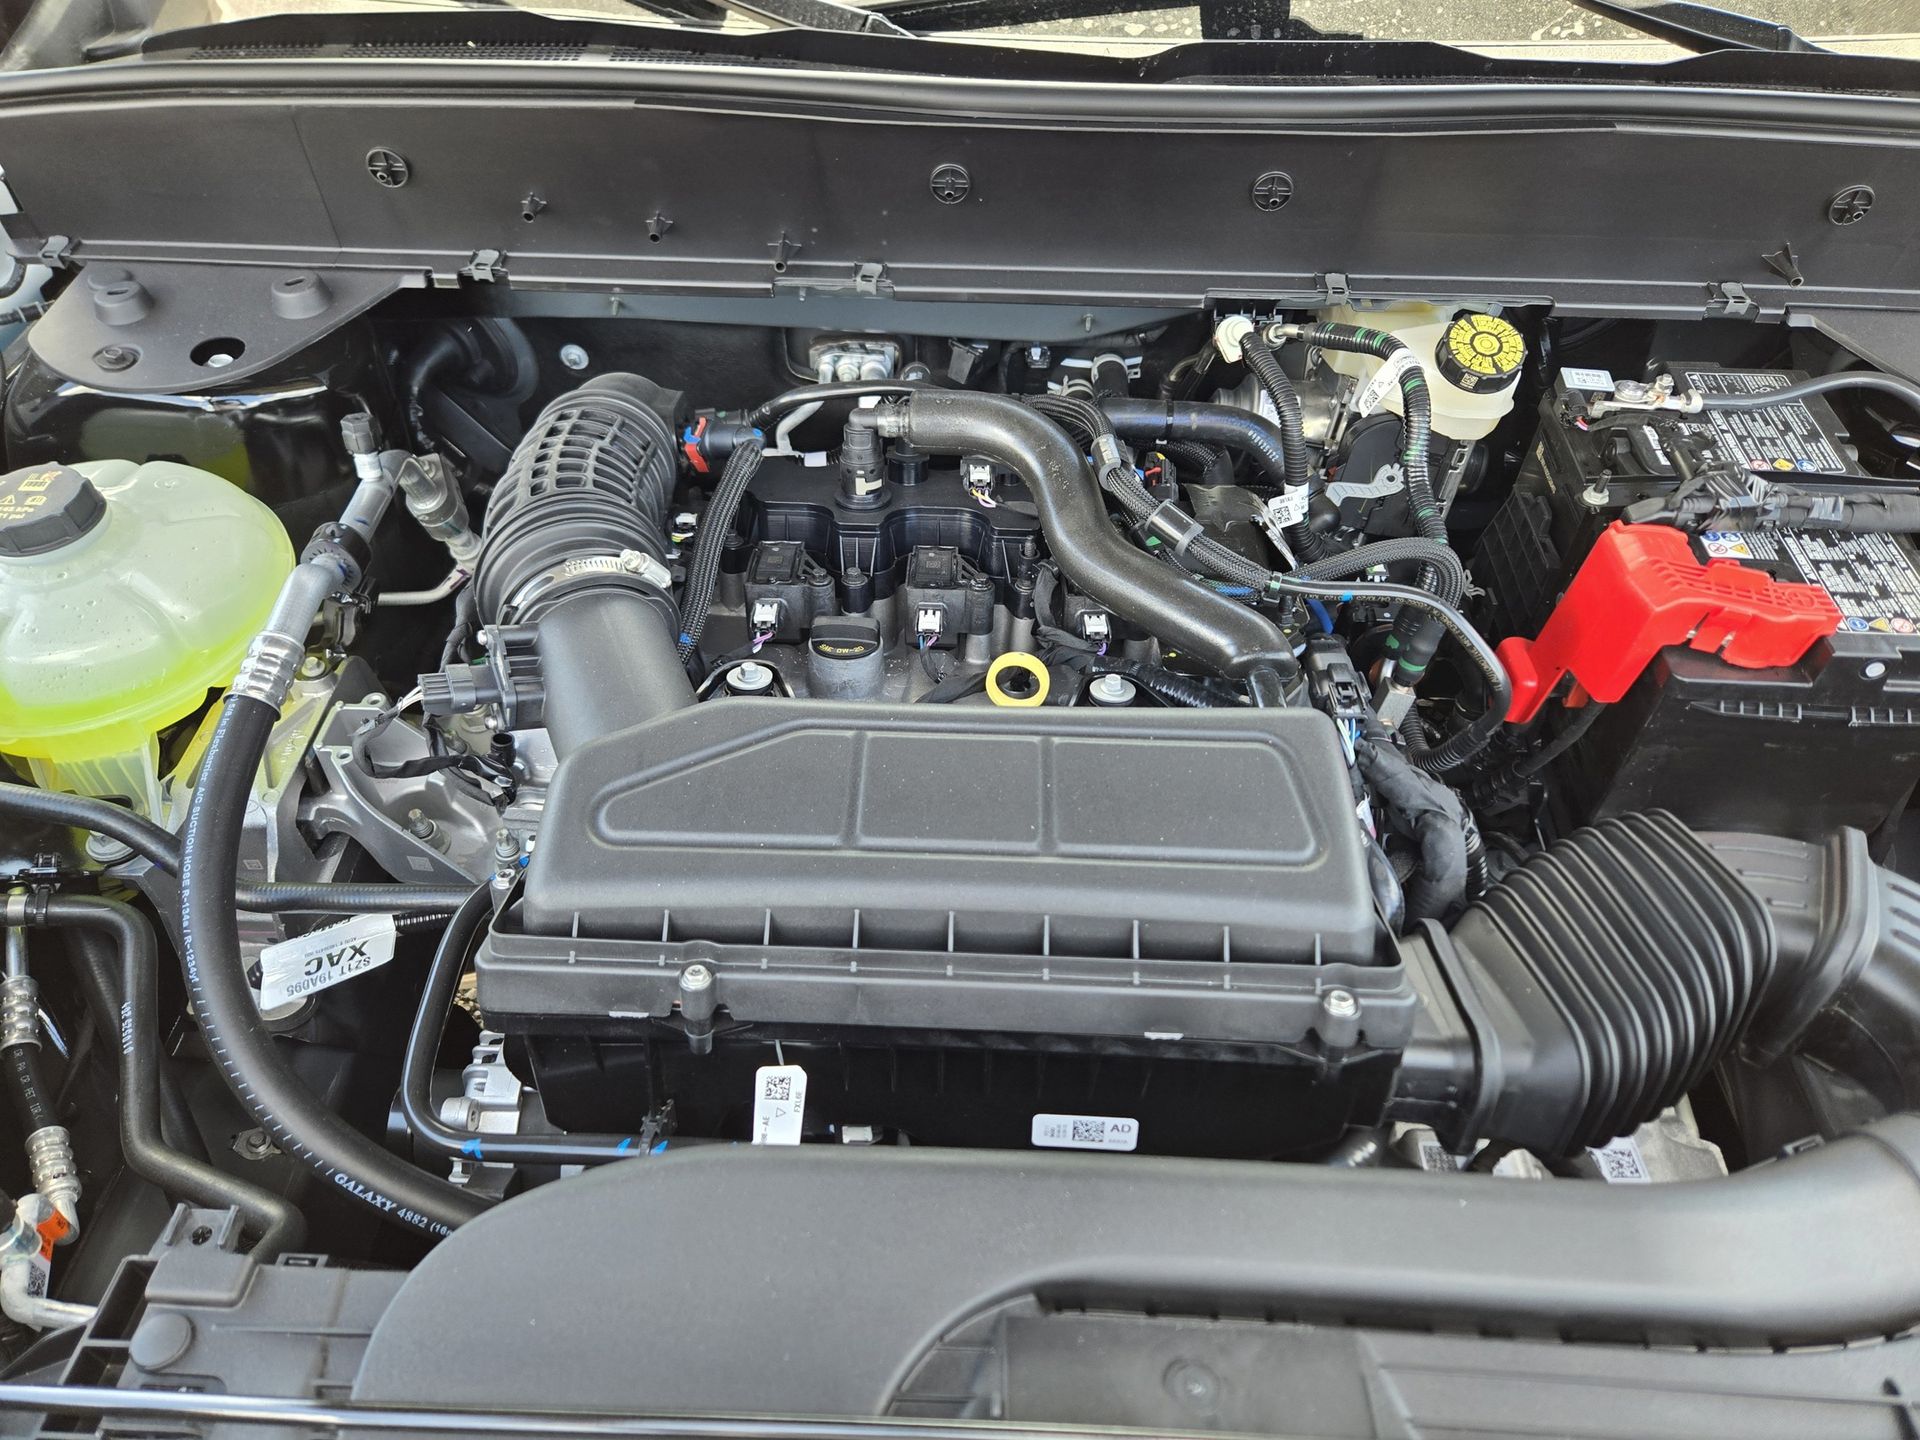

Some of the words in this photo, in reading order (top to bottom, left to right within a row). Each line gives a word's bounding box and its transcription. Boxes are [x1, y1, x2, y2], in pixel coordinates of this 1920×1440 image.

[819, 644, 834, 652] SAE
[836, 646, 864, 654] 0W-20
[198, 727, 226, 783] Flexbarrier
[184, 805, 201, 853] SUCTION
[182, 855, 192, 886] HOSE
[181, 888, 190, 927] R-134a
[181, 935, 200, 982] R-1234yf
[304, 940, 369, 976] XAC
[286, 971, 332, 997] 19AD95
[1110, 1124, 1131, 1133] AD
[334, 1173, 397, 1212] GALAXY
[397, 1208, 428, 1228] 4882
